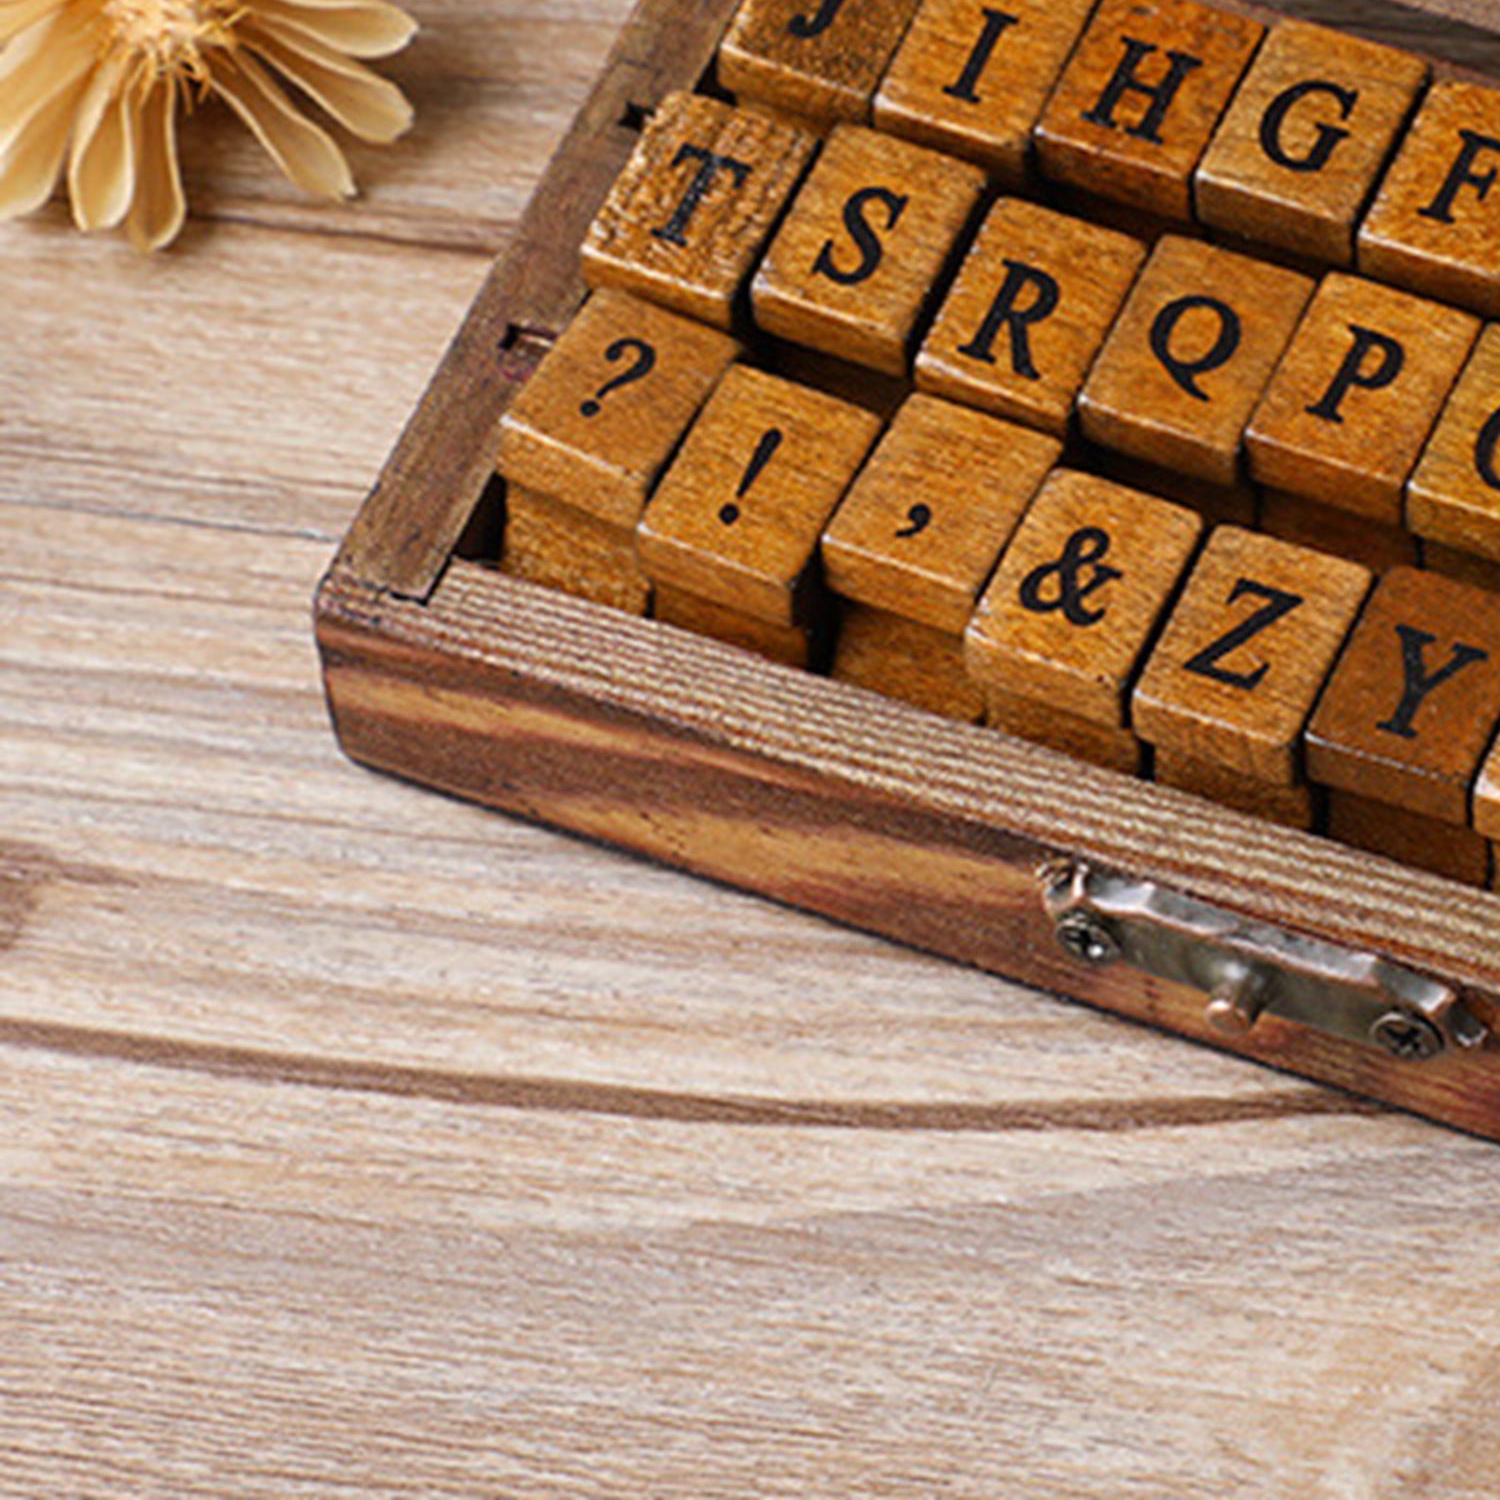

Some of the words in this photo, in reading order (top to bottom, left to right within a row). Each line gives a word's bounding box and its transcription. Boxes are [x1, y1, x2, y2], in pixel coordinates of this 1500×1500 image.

[942, 8, 1019, 104] I
[1081, 36, 1203, 145] H
[1259, 80, 1358, 172] G
[650, 142, 754, 247] T
[811, 187, 908, 286] S
[958, 259, 1060, 380] R
[1149, 295, 1242, 402] Q
[1305, 325, 1405, 424] P
[580, 337, 656, 417] ?
[719, 428, 783, 525] !
[895, 504, 932, 538] ,
[1019, 527, 1123, 627] &
[1183, 578, 1303, 691] Z
[1376, 623, 1488, 739] Y
